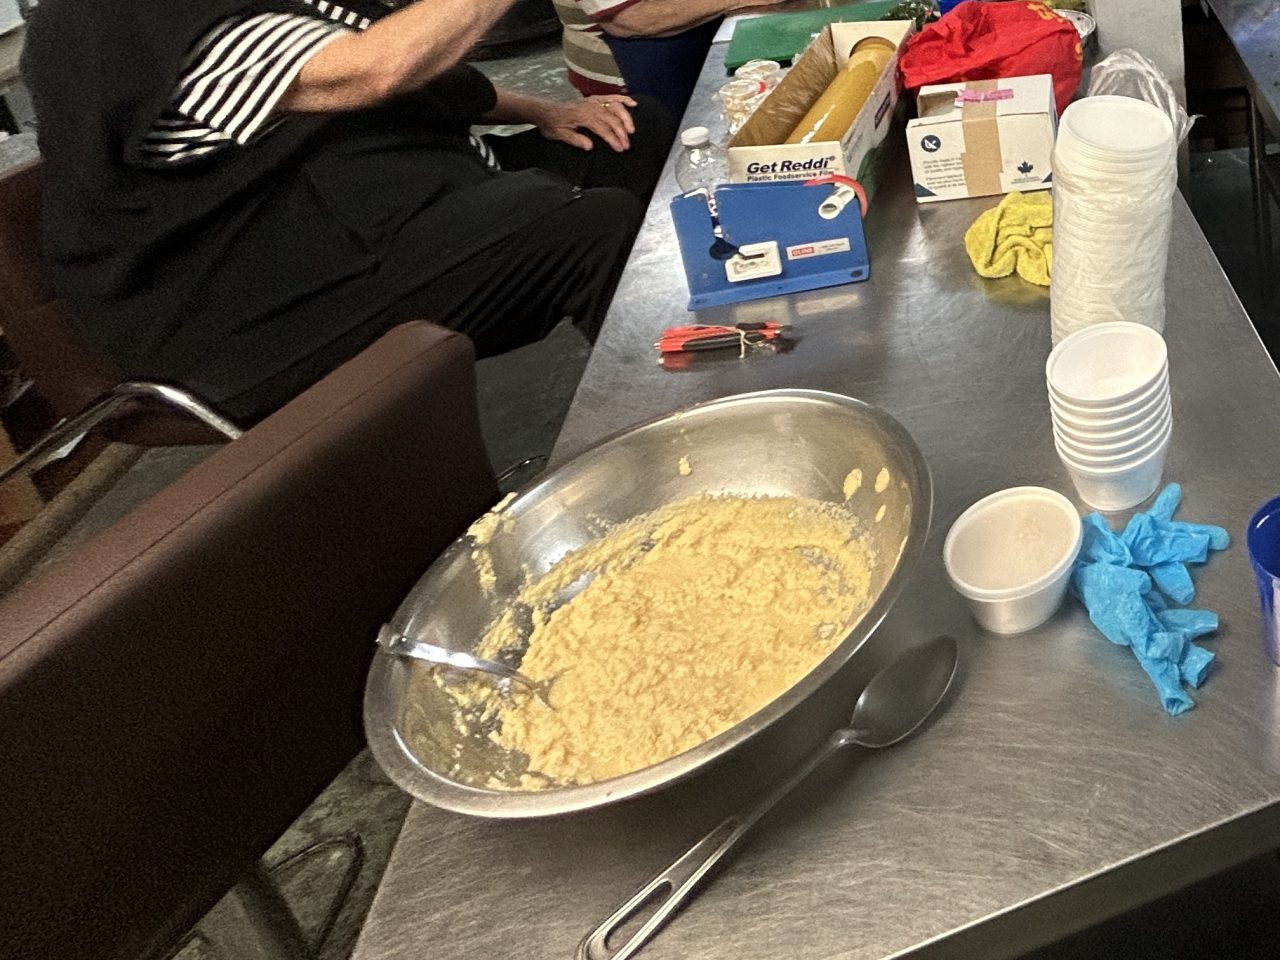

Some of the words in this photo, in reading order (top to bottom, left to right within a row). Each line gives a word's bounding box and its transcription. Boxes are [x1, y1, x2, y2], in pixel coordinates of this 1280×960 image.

[747, 161, 778, 174] Get
[747, 174, 772, 182] Plastic
[773, 170, 817, 181] Foodservice
